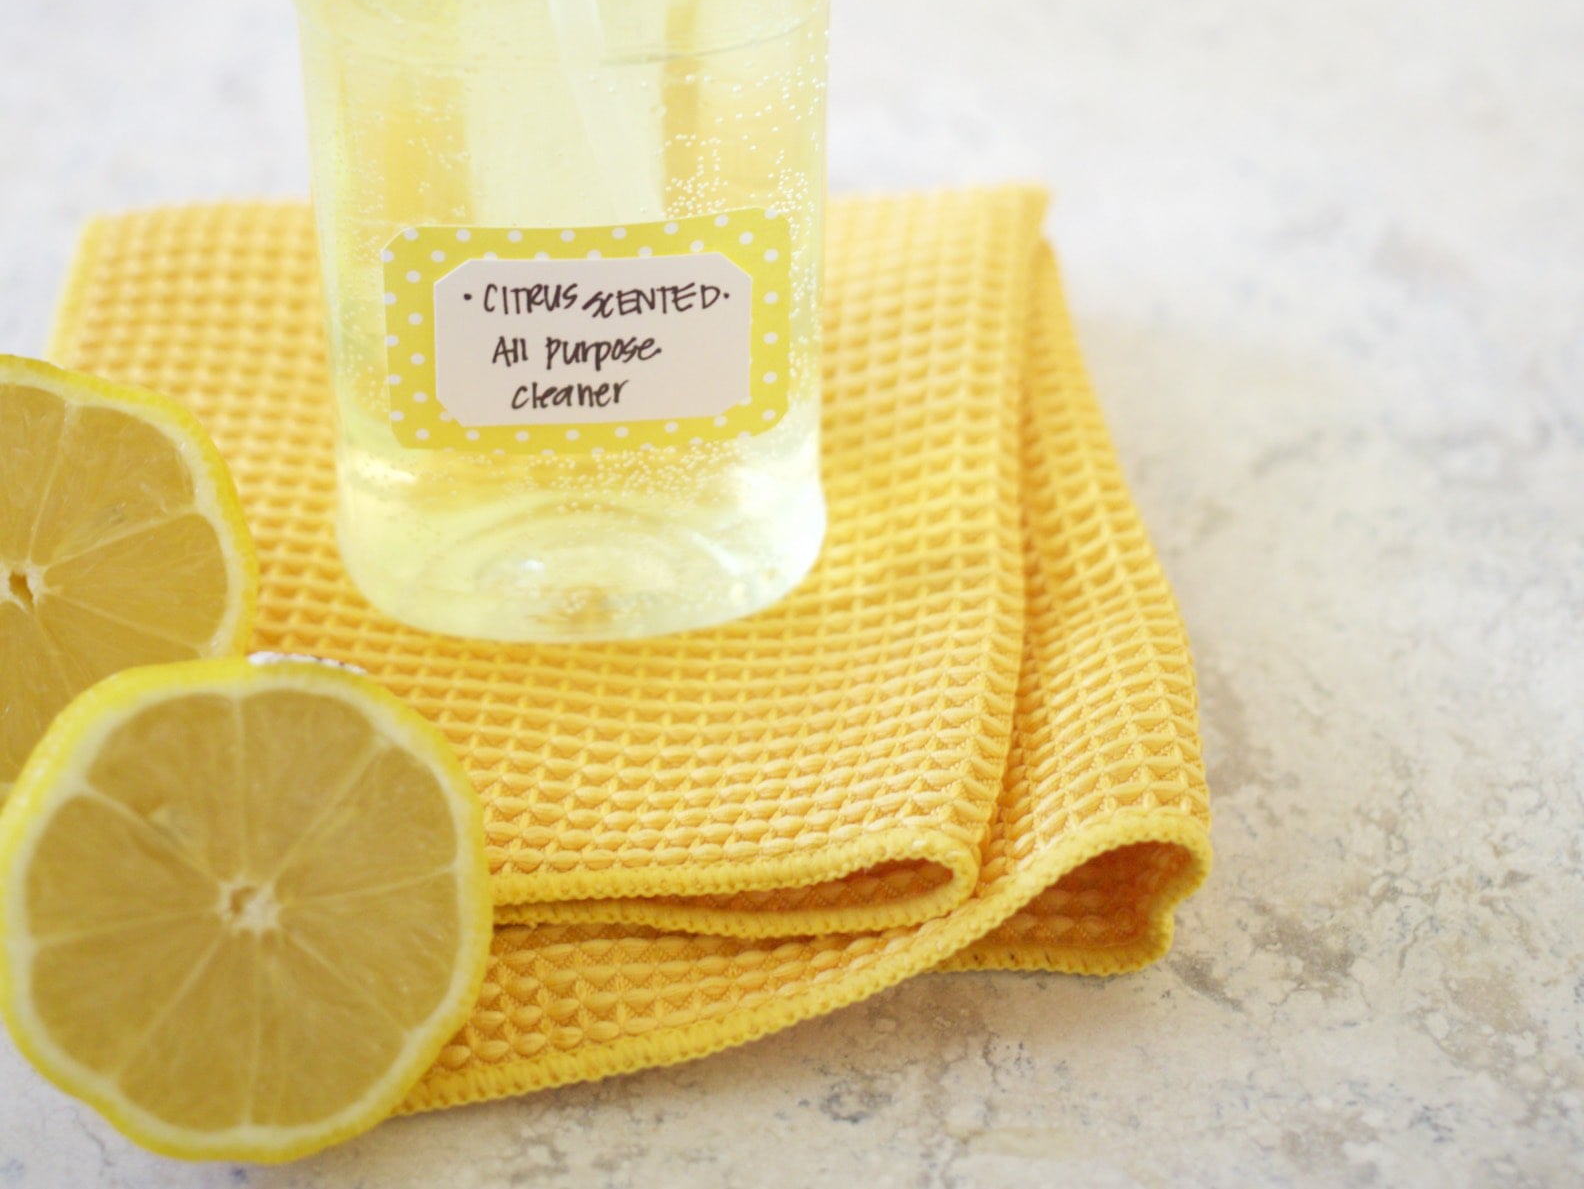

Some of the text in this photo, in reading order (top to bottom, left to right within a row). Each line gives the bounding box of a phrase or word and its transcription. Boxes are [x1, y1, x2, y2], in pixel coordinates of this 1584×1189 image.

[483, 283, 578, 314] CITRUS
[492, 335, 529, 368] All
[511, 379, 630, 410] cleaner
